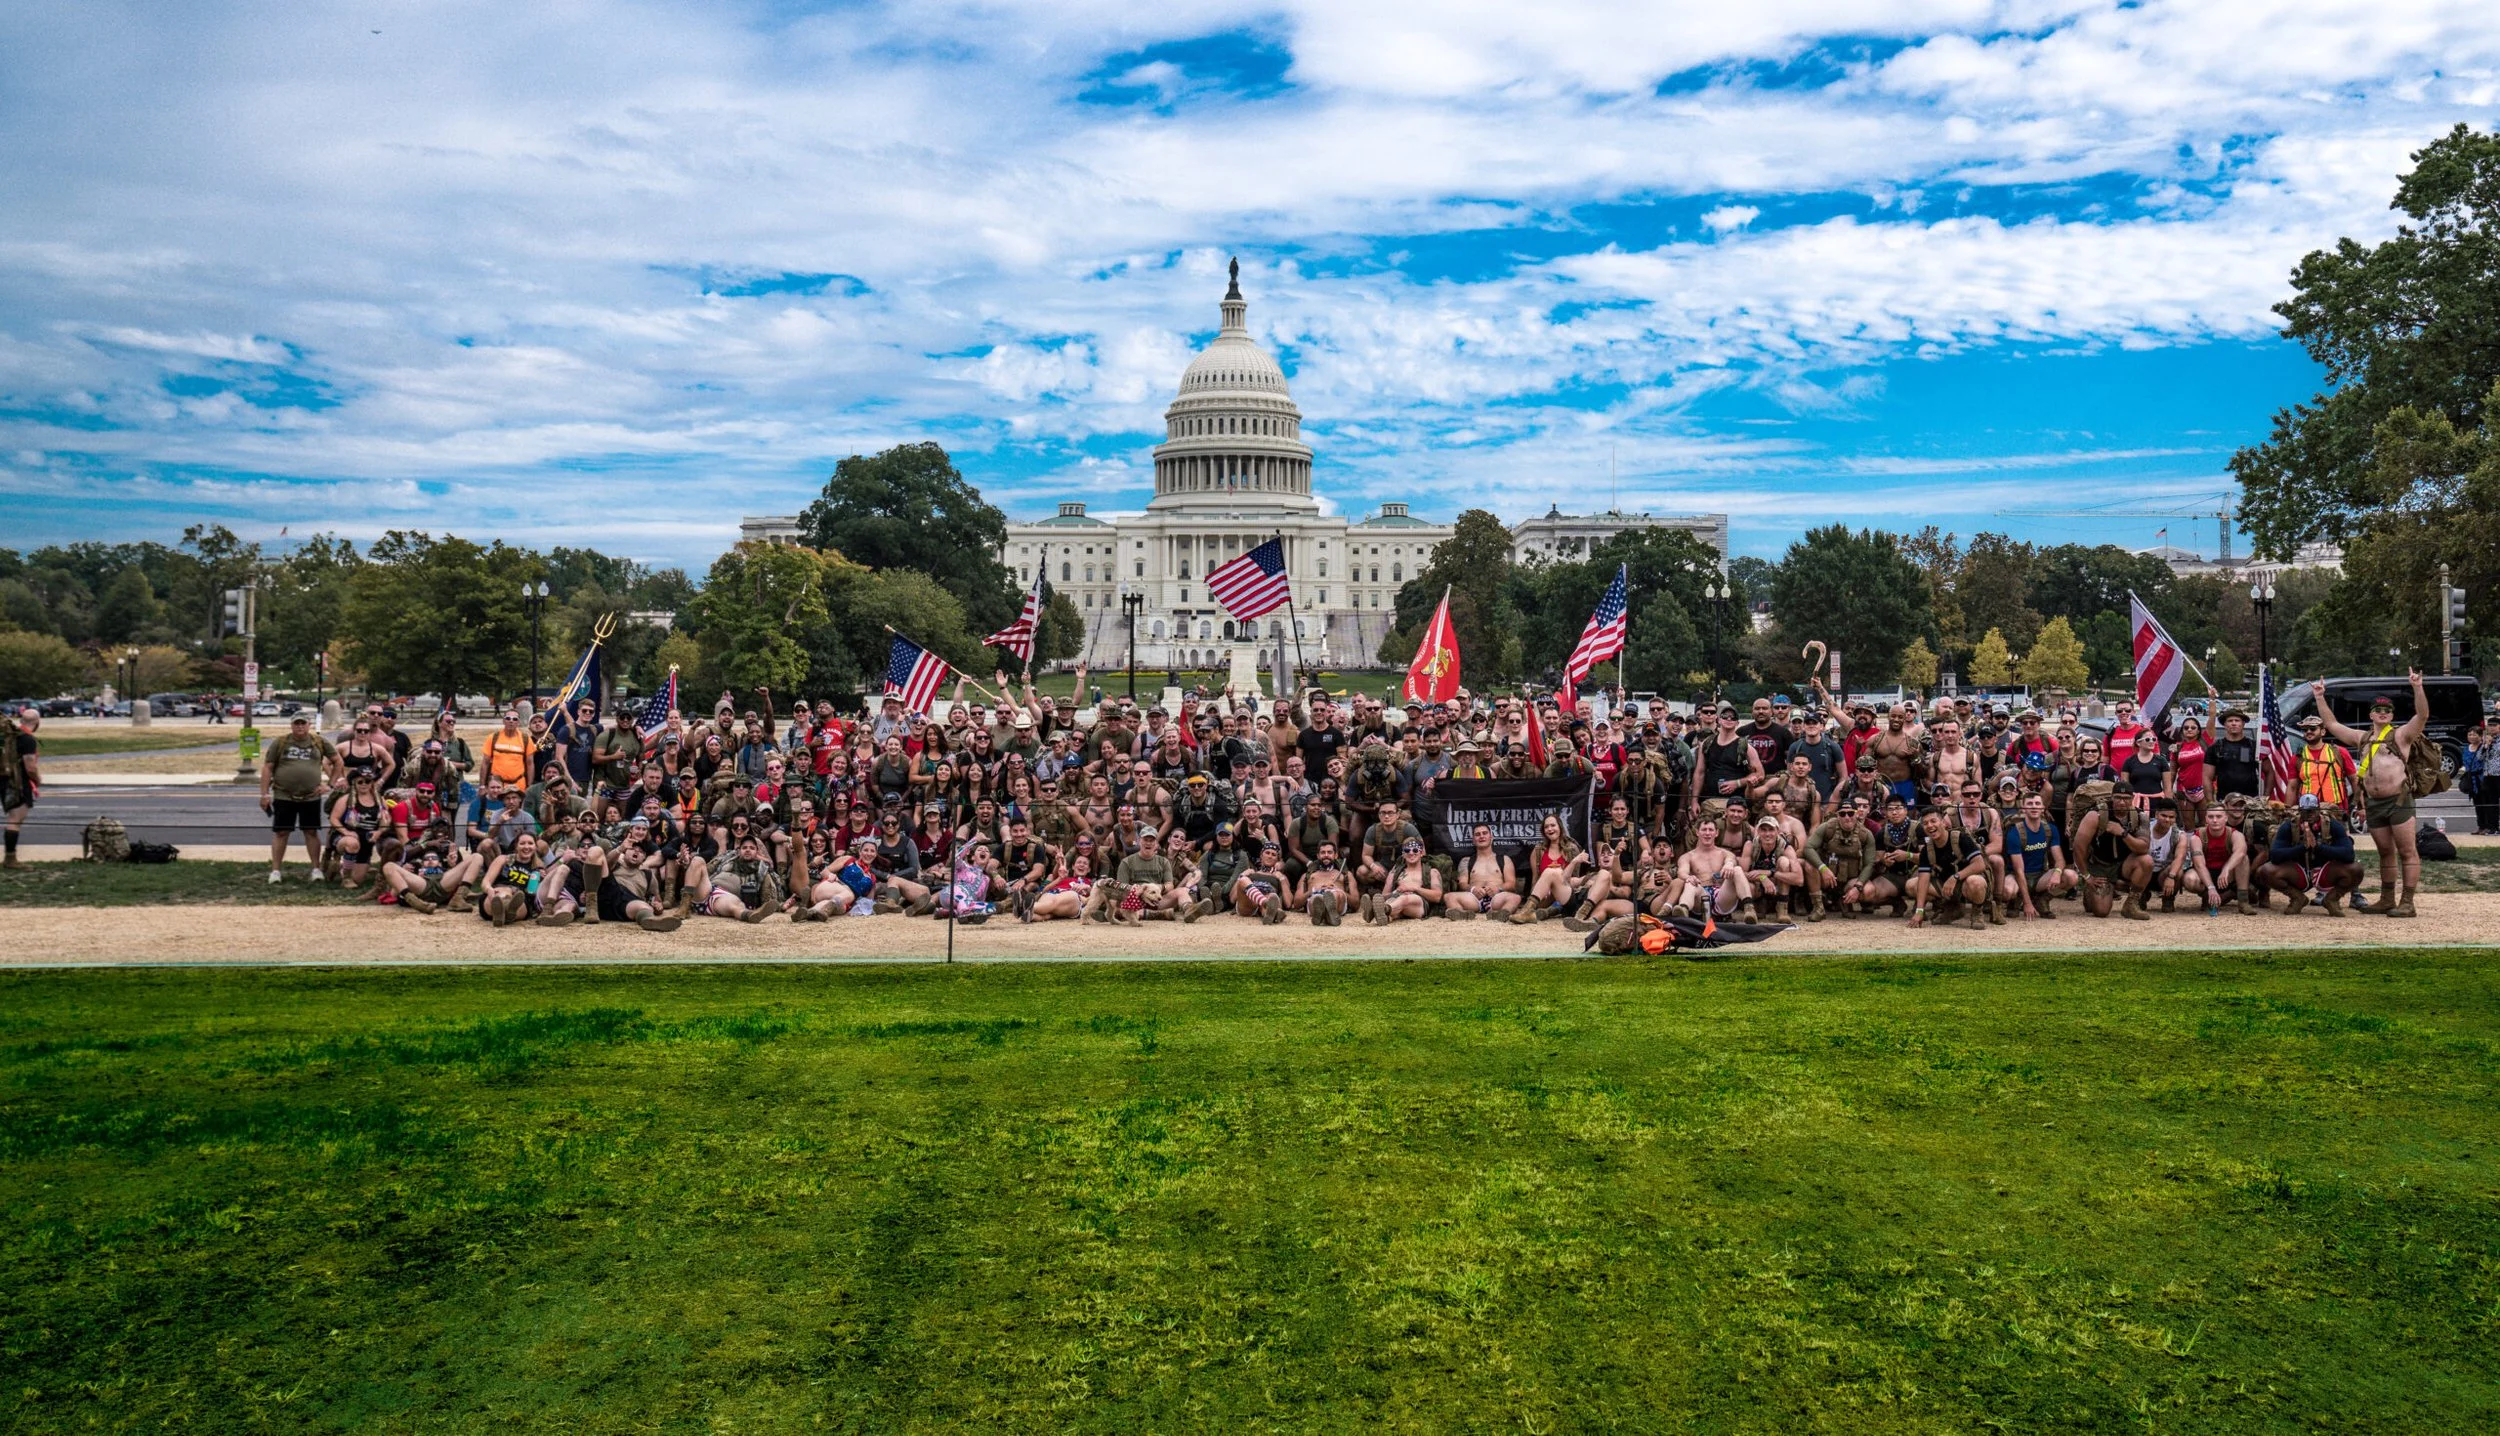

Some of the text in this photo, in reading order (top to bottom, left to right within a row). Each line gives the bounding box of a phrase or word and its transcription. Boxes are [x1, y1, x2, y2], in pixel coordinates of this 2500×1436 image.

[1447, 802, 1557, 824] IRREVERENT
[1447, 823, 1534, 842] WARIORS
[508, 870, 530, 885] 75
